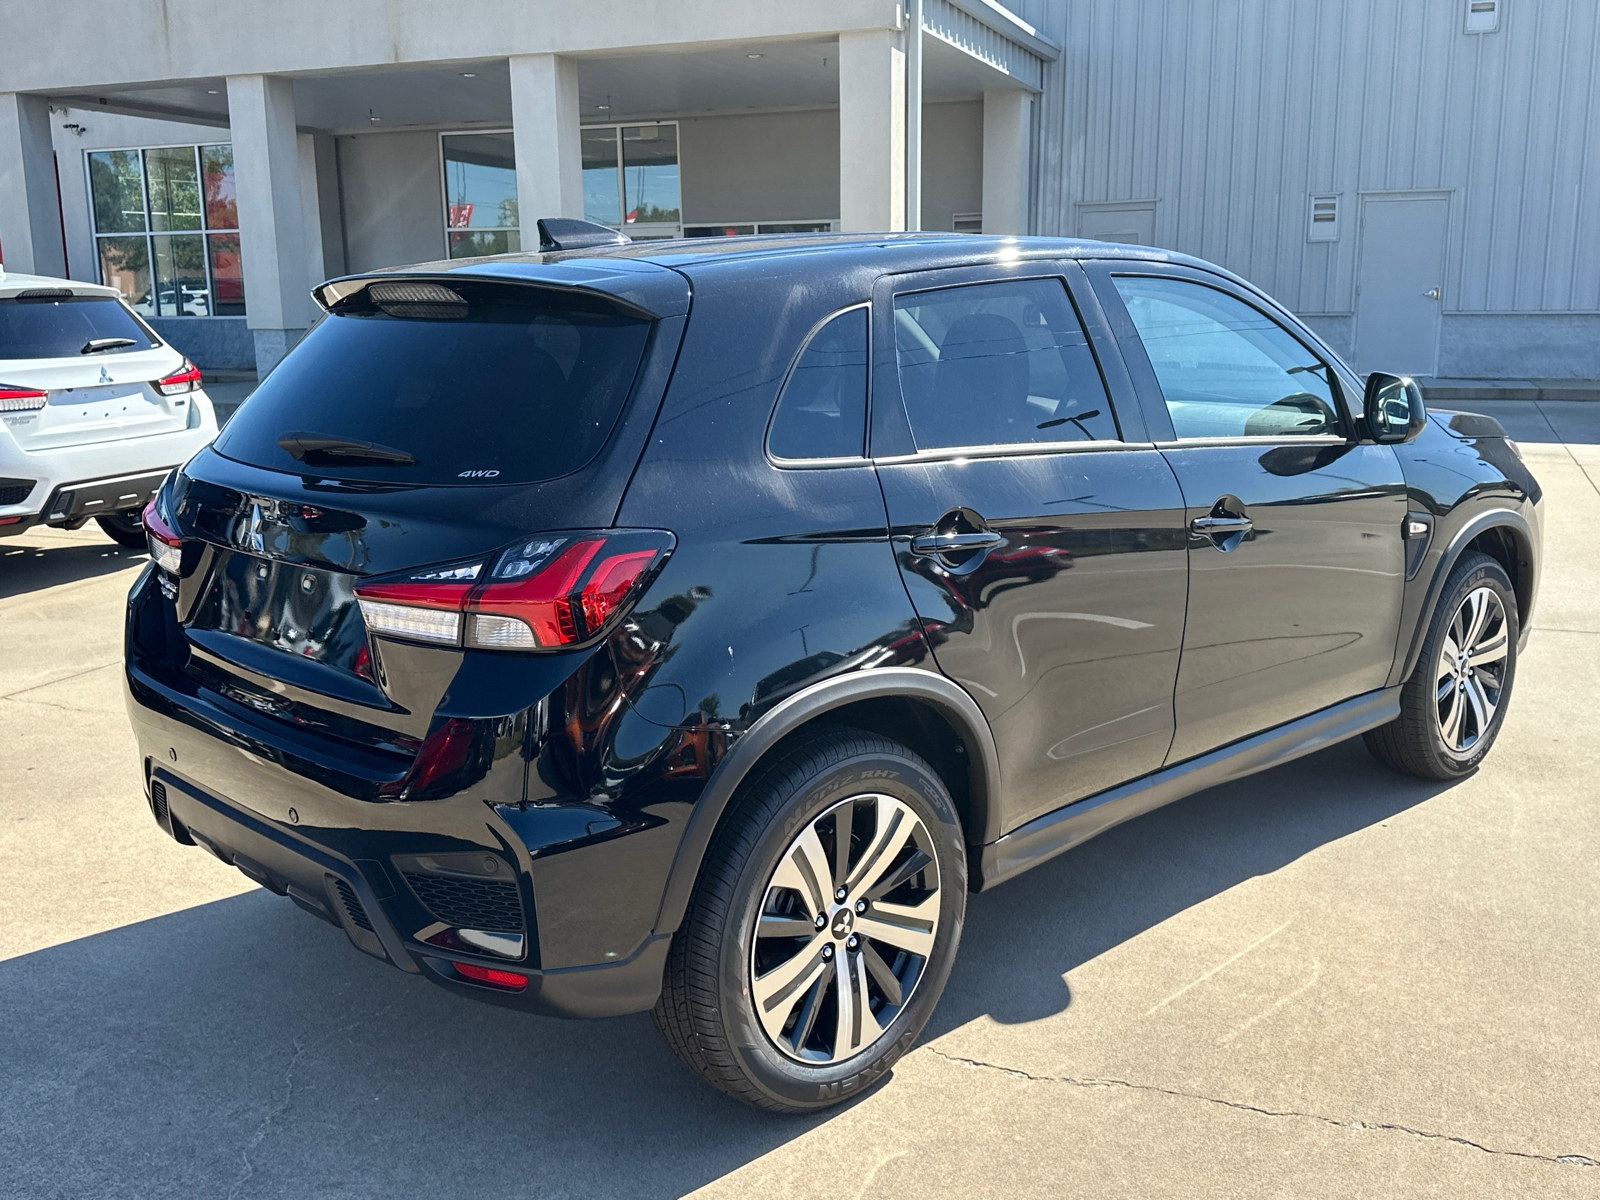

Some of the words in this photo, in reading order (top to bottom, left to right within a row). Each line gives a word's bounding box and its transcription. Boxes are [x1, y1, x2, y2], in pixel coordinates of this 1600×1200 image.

[458, 470, 500, 478] 4WD
[860, 769, 901, 780] RH7
[816, 1020, 921, 1101] NEXEN
